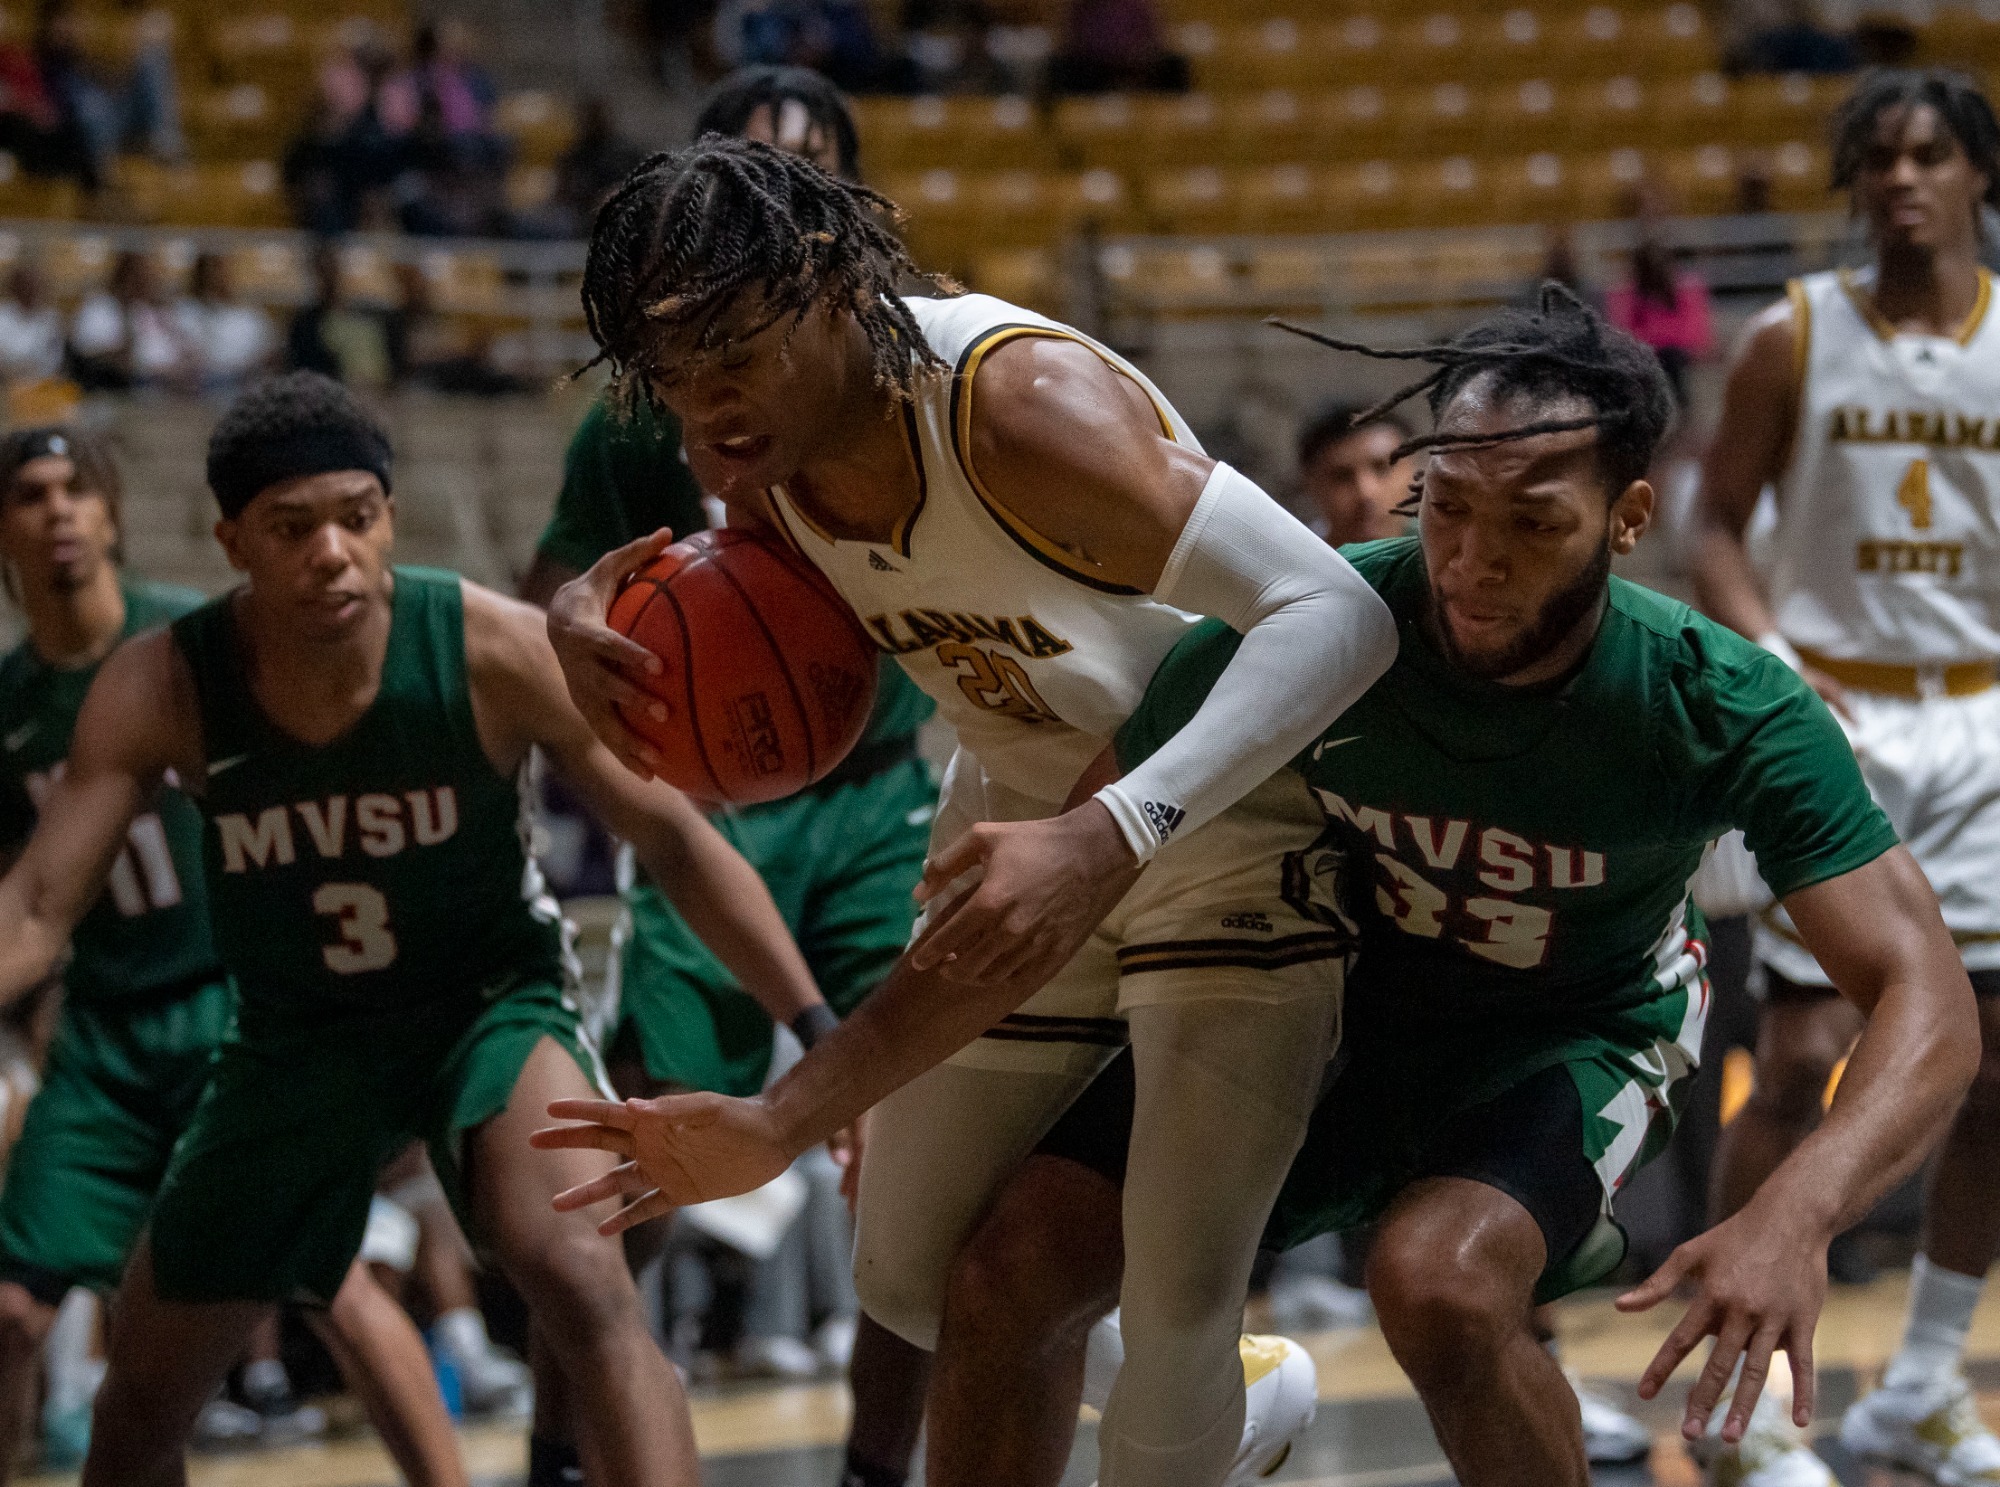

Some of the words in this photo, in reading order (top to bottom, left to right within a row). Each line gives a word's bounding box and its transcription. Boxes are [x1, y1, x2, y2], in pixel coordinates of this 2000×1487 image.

[1896, 459, 1932, 529] 4
[865, 608, 1074, 660] LABAMA
[936, 642, 1063, 724] 20
[215, 787, 459, 874] MVSU
[1313, 788, 1606, 893] MVSU
[312, 882, 398, 975] 3
[1221, 916, 1274, 933] adidas
[1374, 853, 1554, 970] 33
